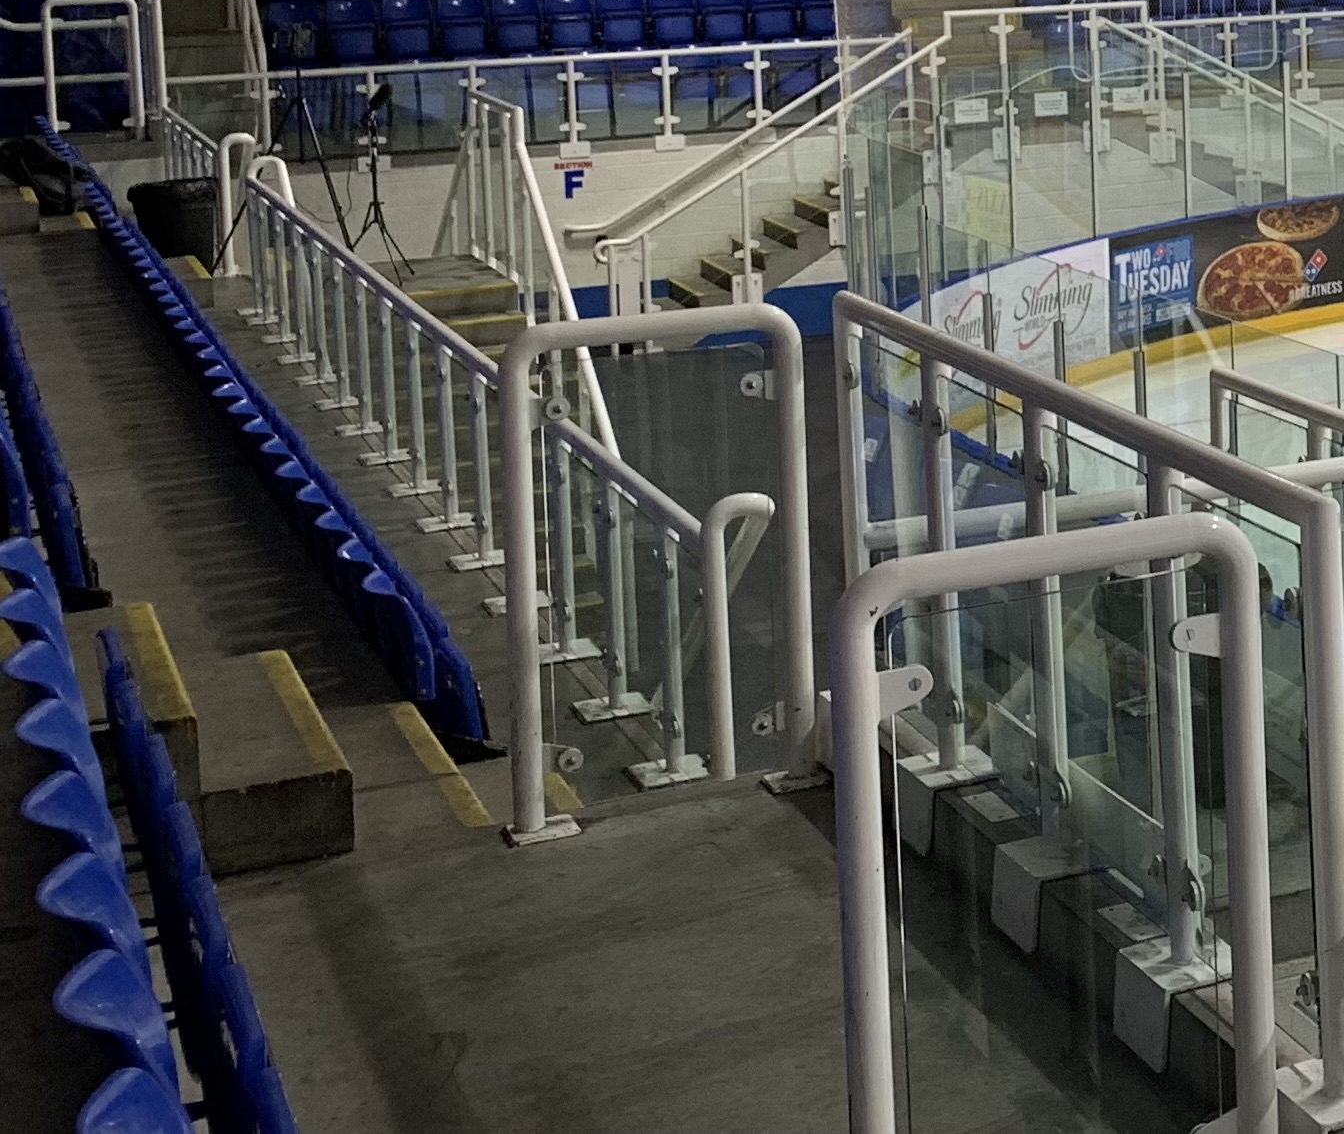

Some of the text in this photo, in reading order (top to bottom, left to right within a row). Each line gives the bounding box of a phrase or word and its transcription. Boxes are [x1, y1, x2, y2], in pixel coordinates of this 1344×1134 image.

[564, 170, 584, 199] F
[1115, 260, 1191, 303] TUESDAY
[1014, 280, 1093, 336] Slimming
